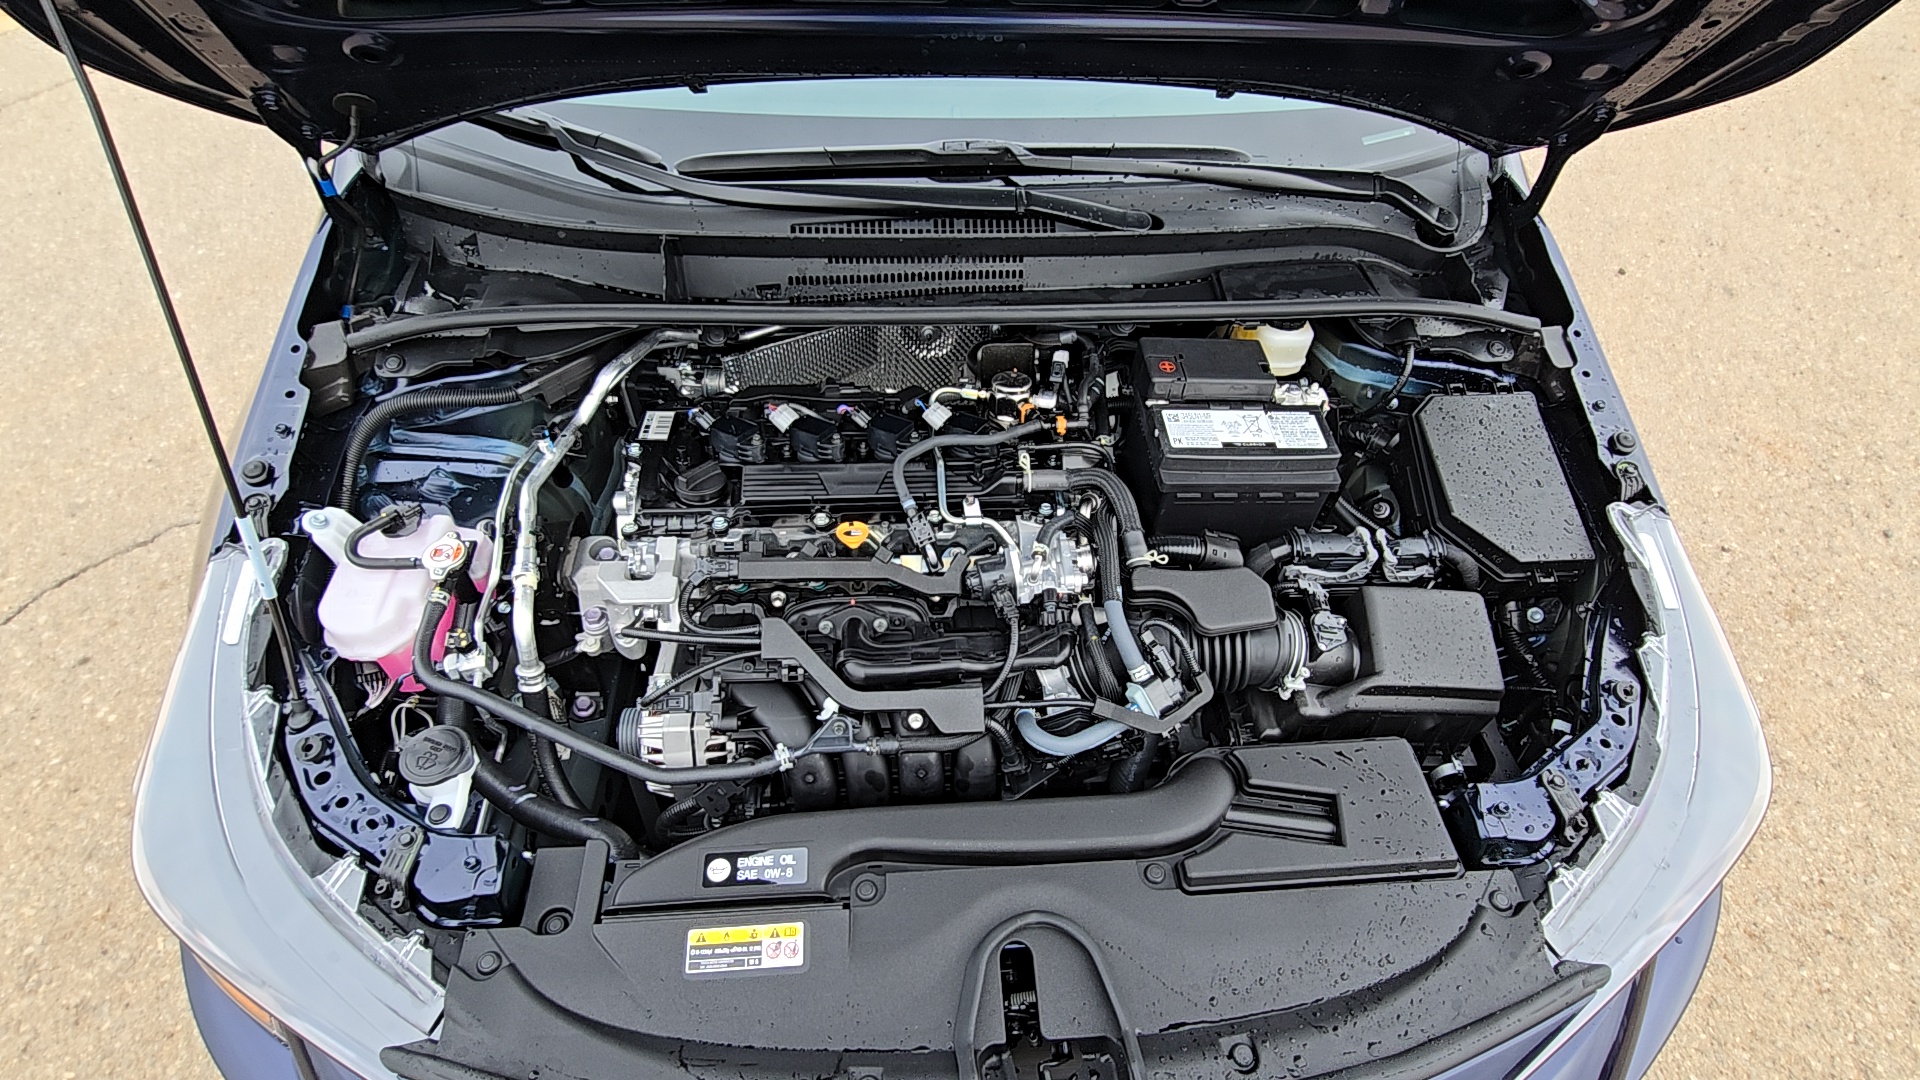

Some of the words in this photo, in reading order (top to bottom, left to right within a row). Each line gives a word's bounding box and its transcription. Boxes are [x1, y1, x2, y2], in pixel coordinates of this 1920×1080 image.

[737, 855, 774, 868] ENGINE
[779, 854, 797, 865] OIL
[736, 869, 758, 880] SAE
[764, 867, 793, 879] 0W-8
